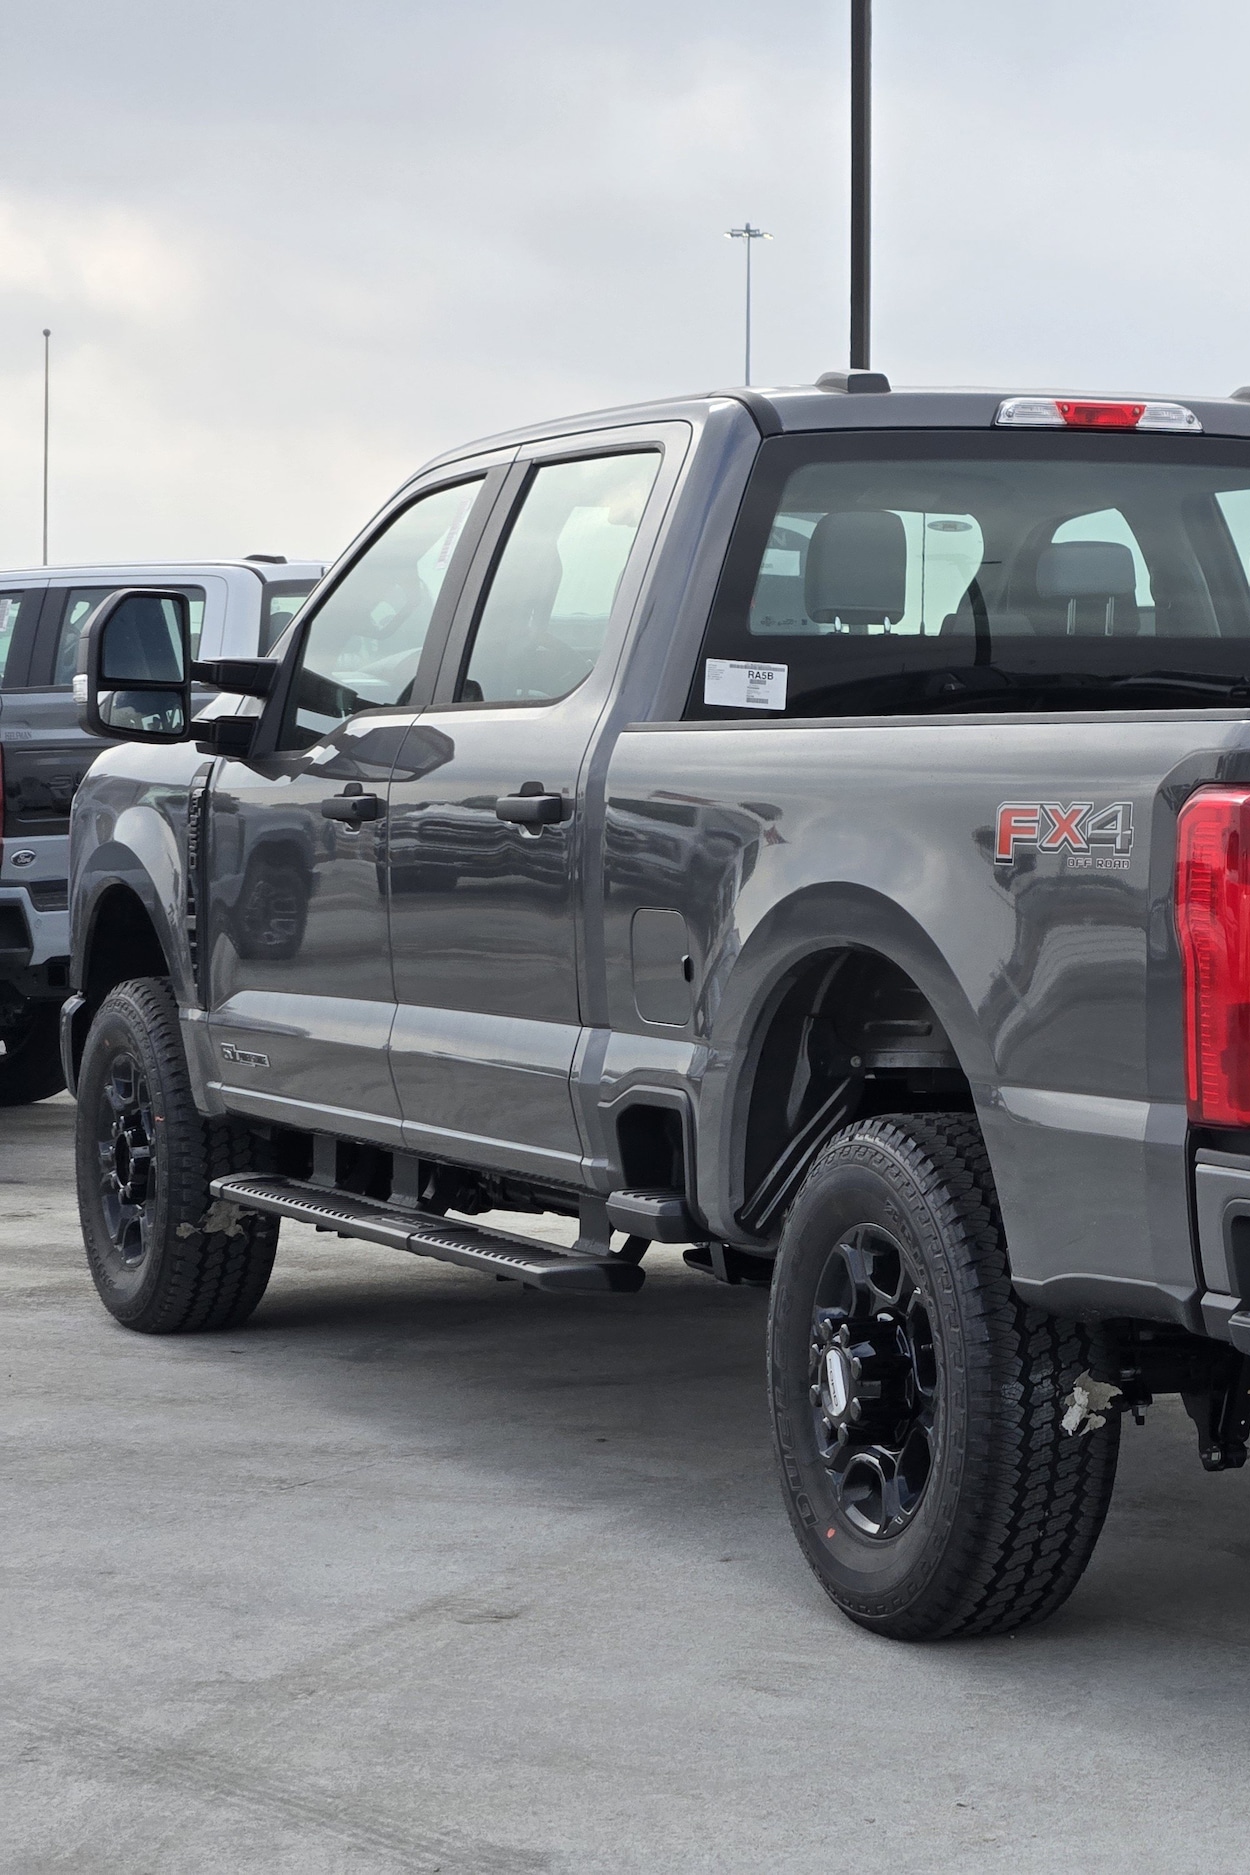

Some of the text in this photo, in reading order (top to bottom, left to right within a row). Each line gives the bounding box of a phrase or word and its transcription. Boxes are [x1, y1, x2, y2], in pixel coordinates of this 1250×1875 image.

[747, 670, 774, 680] RA5B
[994, 801, 1134, 866] FX4
[1067, 857, 1131, 869] OFF ROAD
